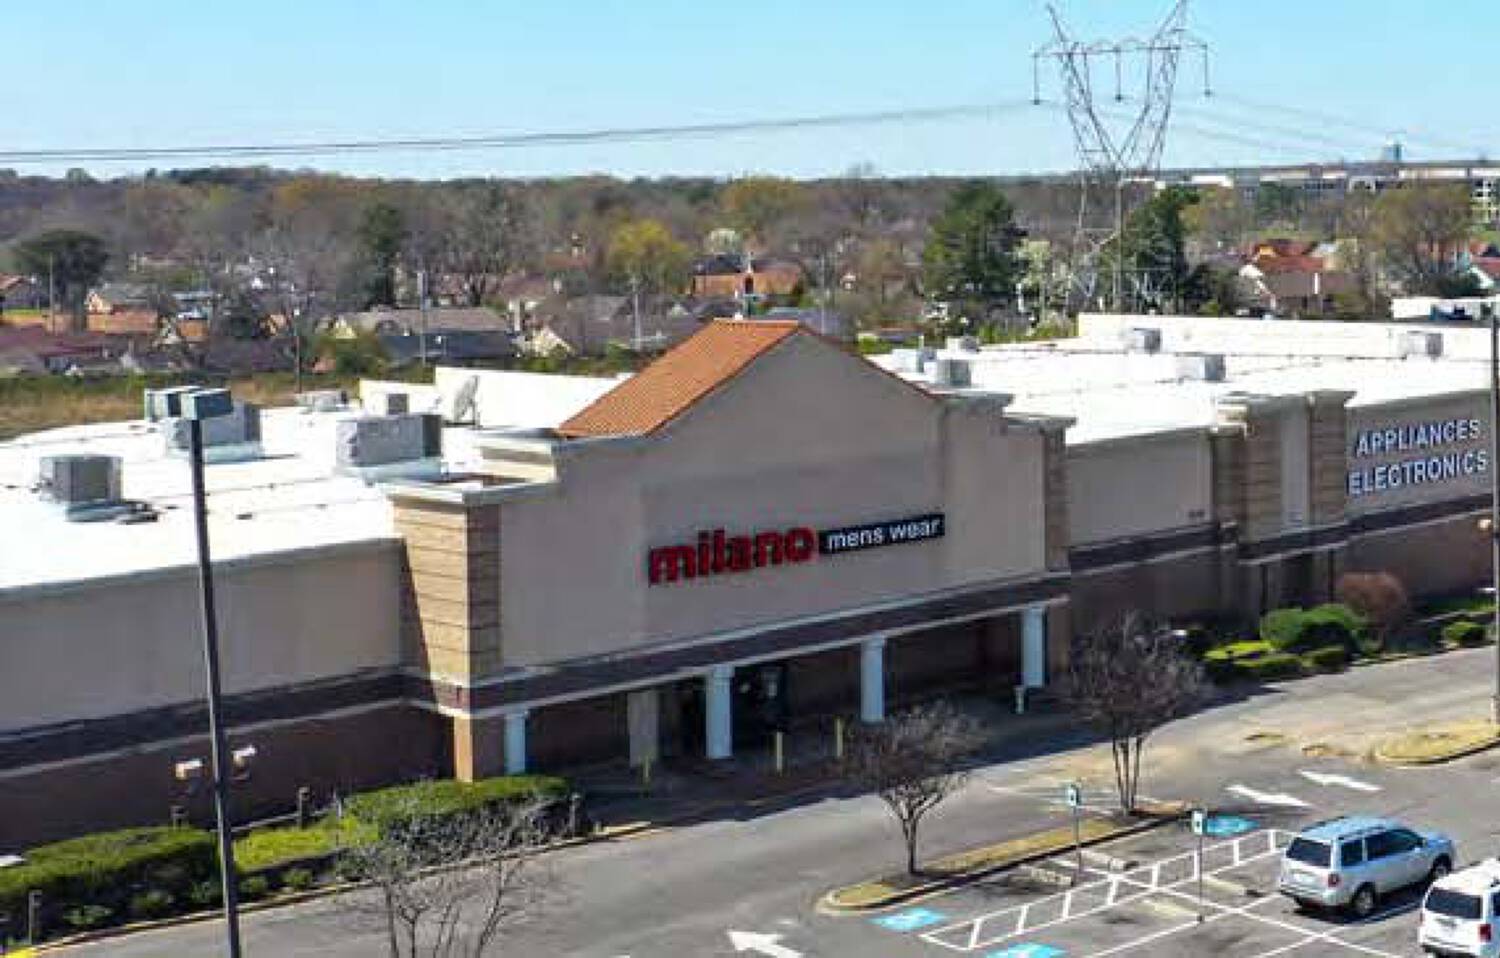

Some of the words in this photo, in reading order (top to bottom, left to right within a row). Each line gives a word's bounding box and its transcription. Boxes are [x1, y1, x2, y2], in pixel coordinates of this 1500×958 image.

[1356, 419, 1481, 458] APPLIANCES
[1350, 450, 1487, 495] ELECTRONICS
[649, 528, 815, 585] milano
[827, 528, 884, 550] mens
[890, 517, 942, 540] wear
